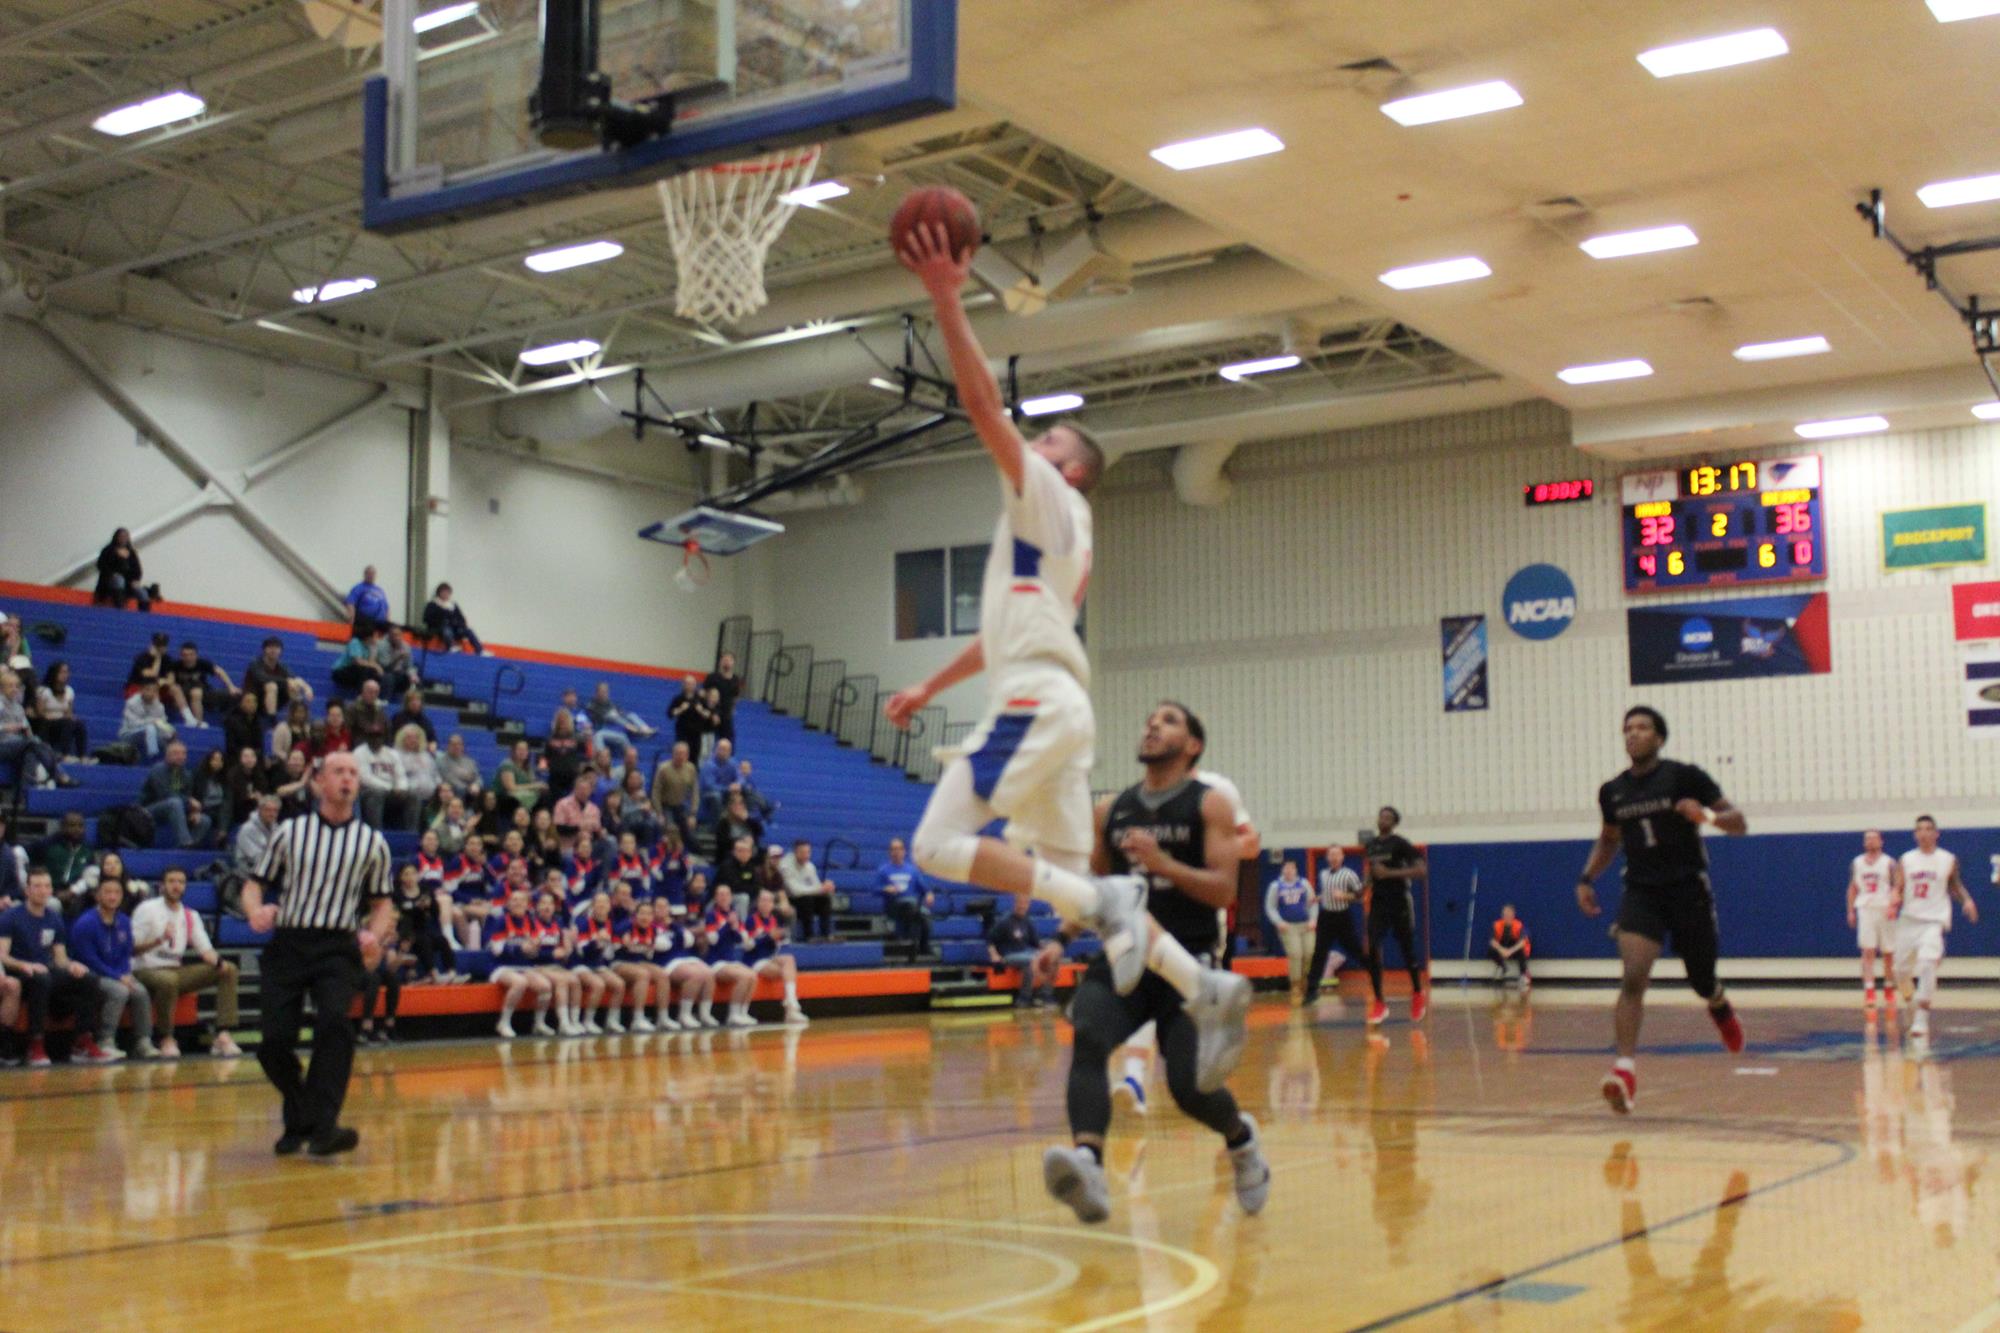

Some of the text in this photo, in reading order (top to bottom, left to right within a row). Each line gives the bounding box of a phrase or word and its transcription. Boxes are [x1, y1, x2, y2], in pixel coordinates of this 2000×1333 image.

[1690, 462, 1757, 496] 13:17
[1641, 515, 1675, 546] 32
[1711, 513, 1728, 537] 2
[1775, 502, 1812, 534] 36
[1639, 555, 1656, 576] 4
[1667, 551, 1684, 576] 6
[1758, 543, 1776, 568] 6
[1794, 540, 1812, 565] 0
[1510, 597, 1575, 624] NCAA
[1640, 818, 1657, 847] 1
